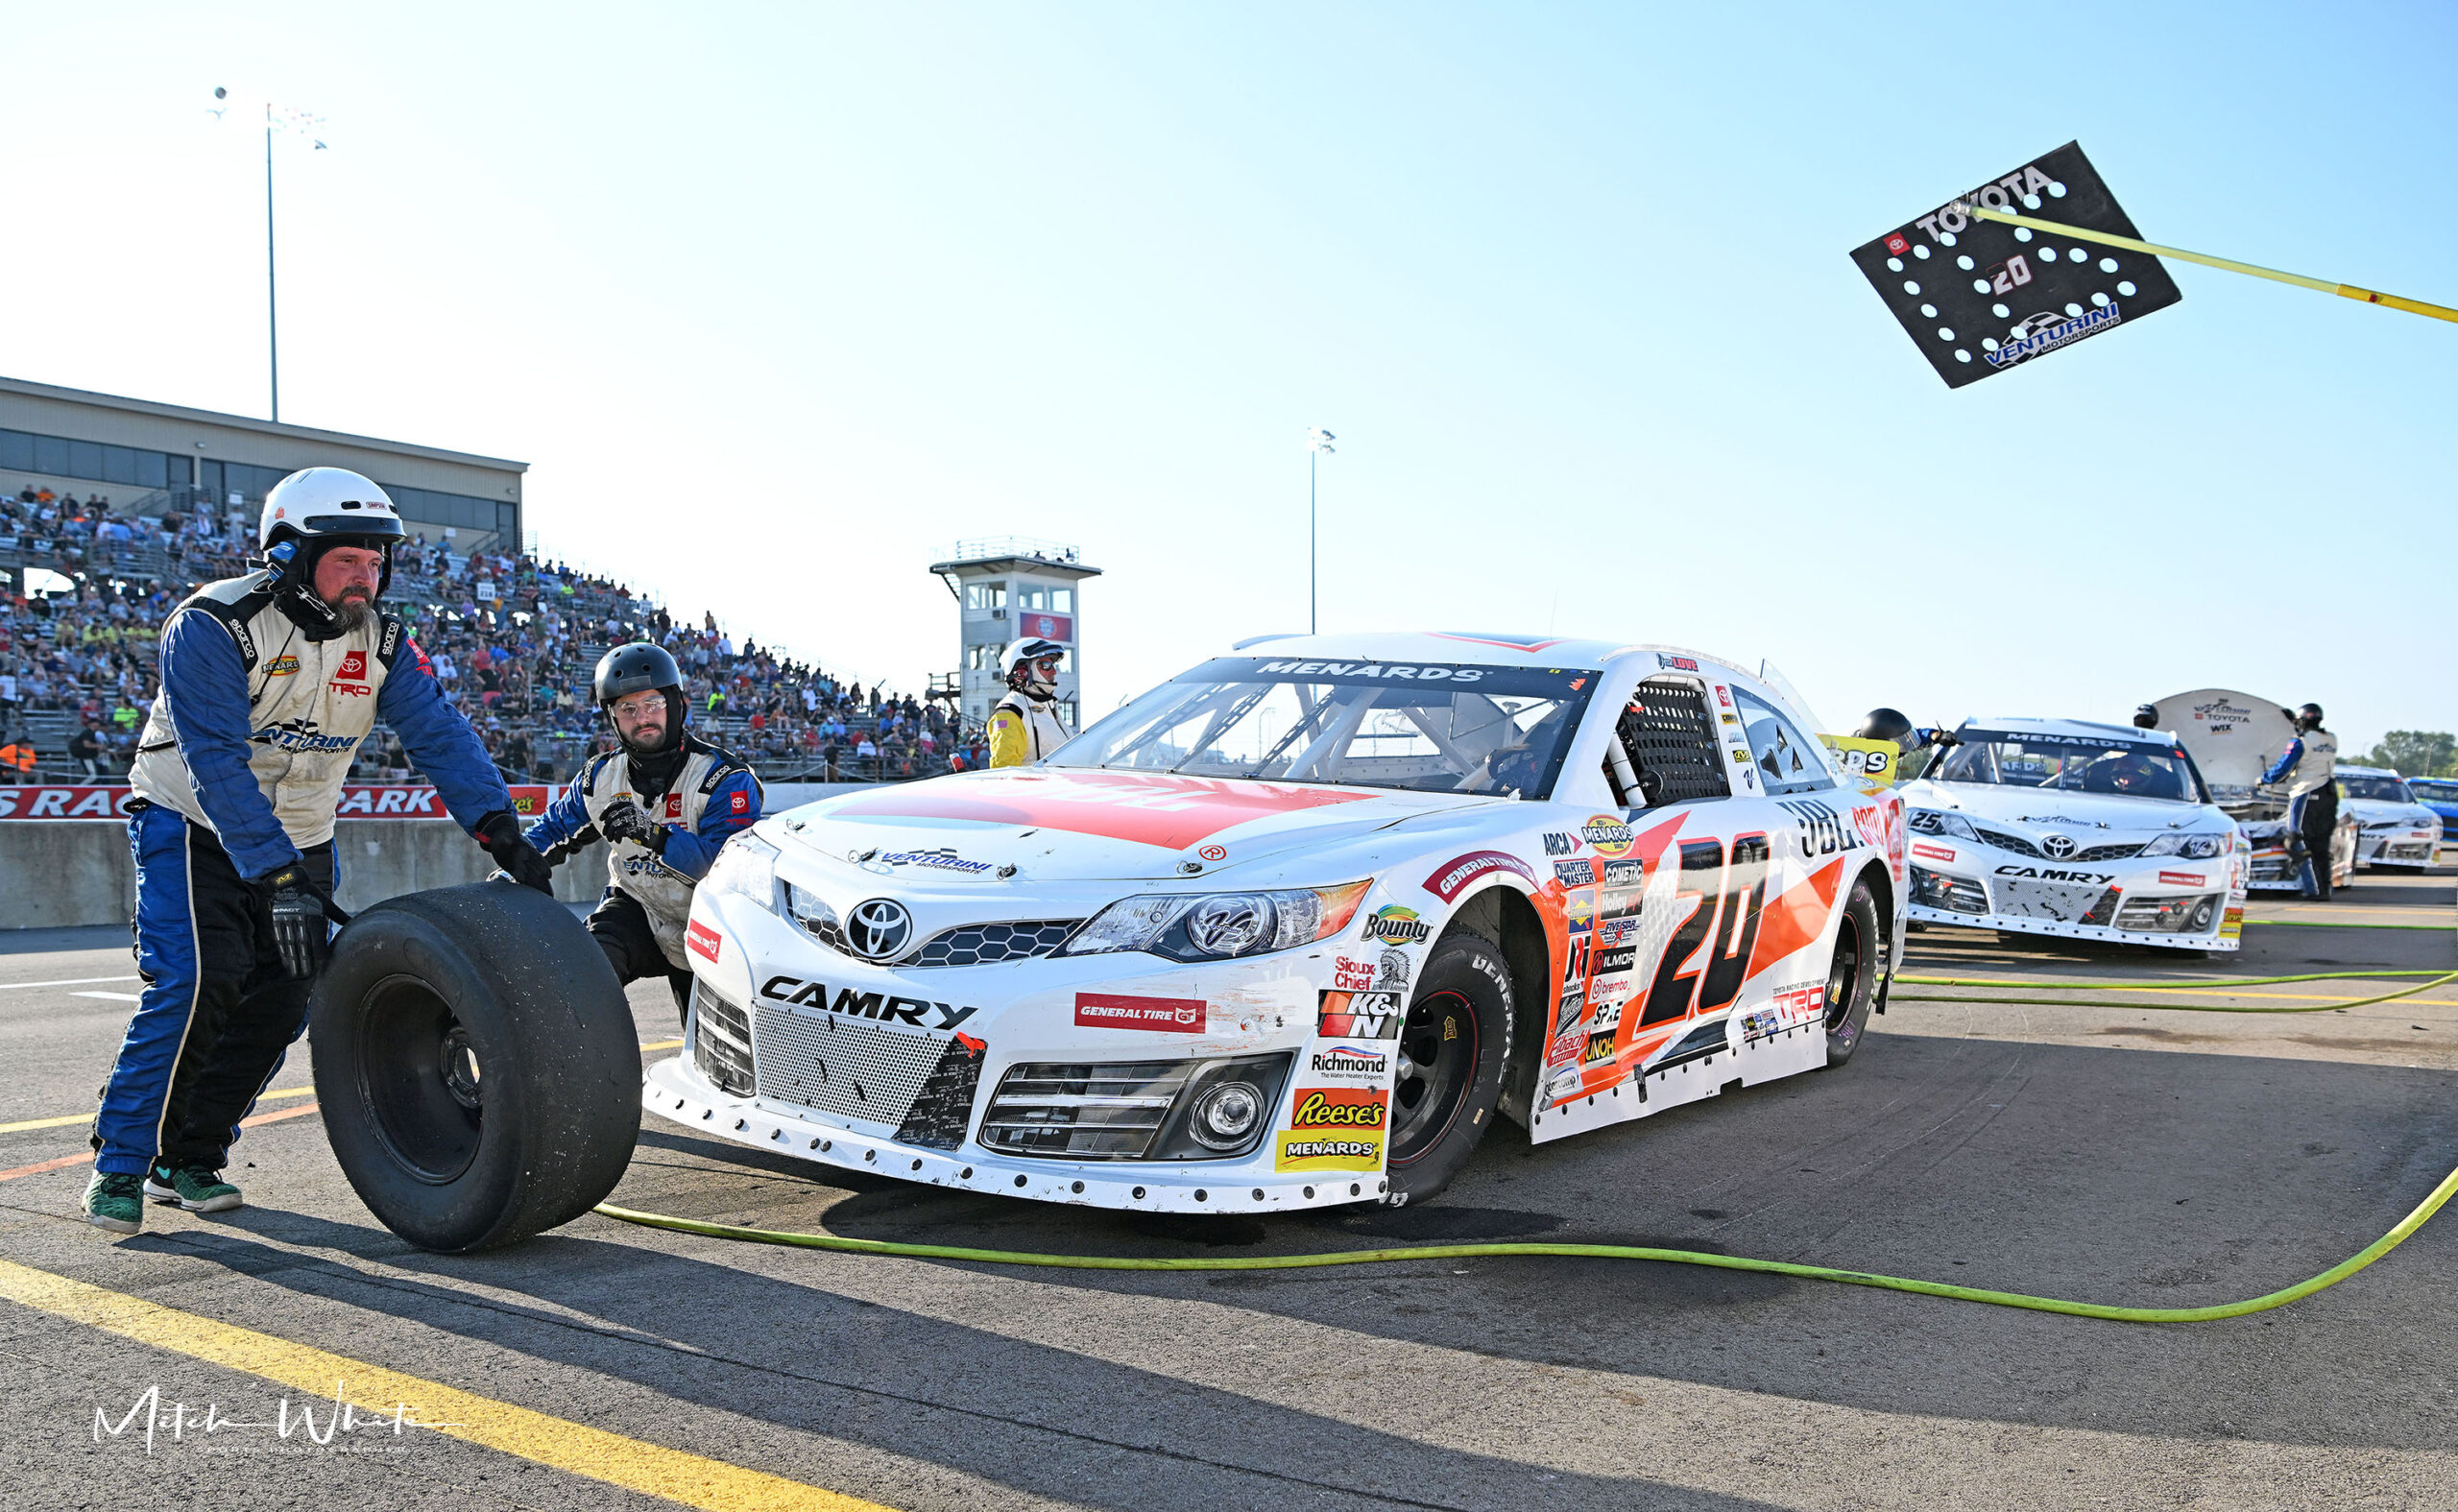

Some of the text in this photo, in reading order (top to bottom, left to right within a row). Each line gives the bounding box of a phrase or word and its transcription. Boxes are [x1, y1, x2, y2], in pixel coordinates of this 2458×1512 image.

[1916, 165, 2055, 242] TOYOTA
[1987, 253, 2033, 296] 20
[1985, 300, 2120, 367] VENTURINI
[2041, 316, 2121, 352] MOTORSPORTS
[229, 618, 256, 659] sparco
[382, 622, 398, 655] sparco
[1256, 660, 1484, 683] MENARDS
[1672, 657, 1699, 672] LOVE
[328, 682, 372, 697] TRD
[2208, 714, 2251, 723] TOYOTA
[2007, 733, 2133, 749] MENARDS
[705, 765, 731, 789] sparco
[1909, 811, 1942, 829] 25
[1543, 832, 1572, 855] ARCA
[1581, 825, 1634, 844] MENARDS
[882, 852, 993, 872] VENTURINI
[916, 862, 981, 875] MOTORSPORTS
[1555, 860, 1590, 879] QUARTER
[1439, 857, 1496, 895] GENERAL
[1564, 872, 1595, 887] MASTER
[1605, 865, 1643, 882] COMETIC
[1994, 865, 2115, 883] CAMRY
[1602, 894, 1627, 915] Holley
[1361, 913, 1433, 945] Bounty
[1605, 920, 1637, 932] FIVE STAR
[1636, 830, 1771, 1034] 20
[1335, 956, 1376, 975] Sioux
[1603, 951, 1636, 968] ILMOR
[1335, 972, 1372, 991] Chief
[1563, 982, 1580, 995] shocks
[1602, 980, 1628, 994] brembo
[759, 975, 979, 1030] CAMRY
[1346, 994, 1399, 1016] K&
[1772, 987, 1824, 1024] TRD
[1080, 1006, 1141, 1019] GENERAL
[1142, 1009, 1173, 1020] TIRE
[1549, 1029, 1586, 1054] Eibach
[1585, 1037, 1615, 1061] UNOH
[1312, 1053, 1385, 1072] Richmond
[1293, 1092, 1386, 1125] Reese's
[1286, 1141, 1375, 1157] MENARDS
